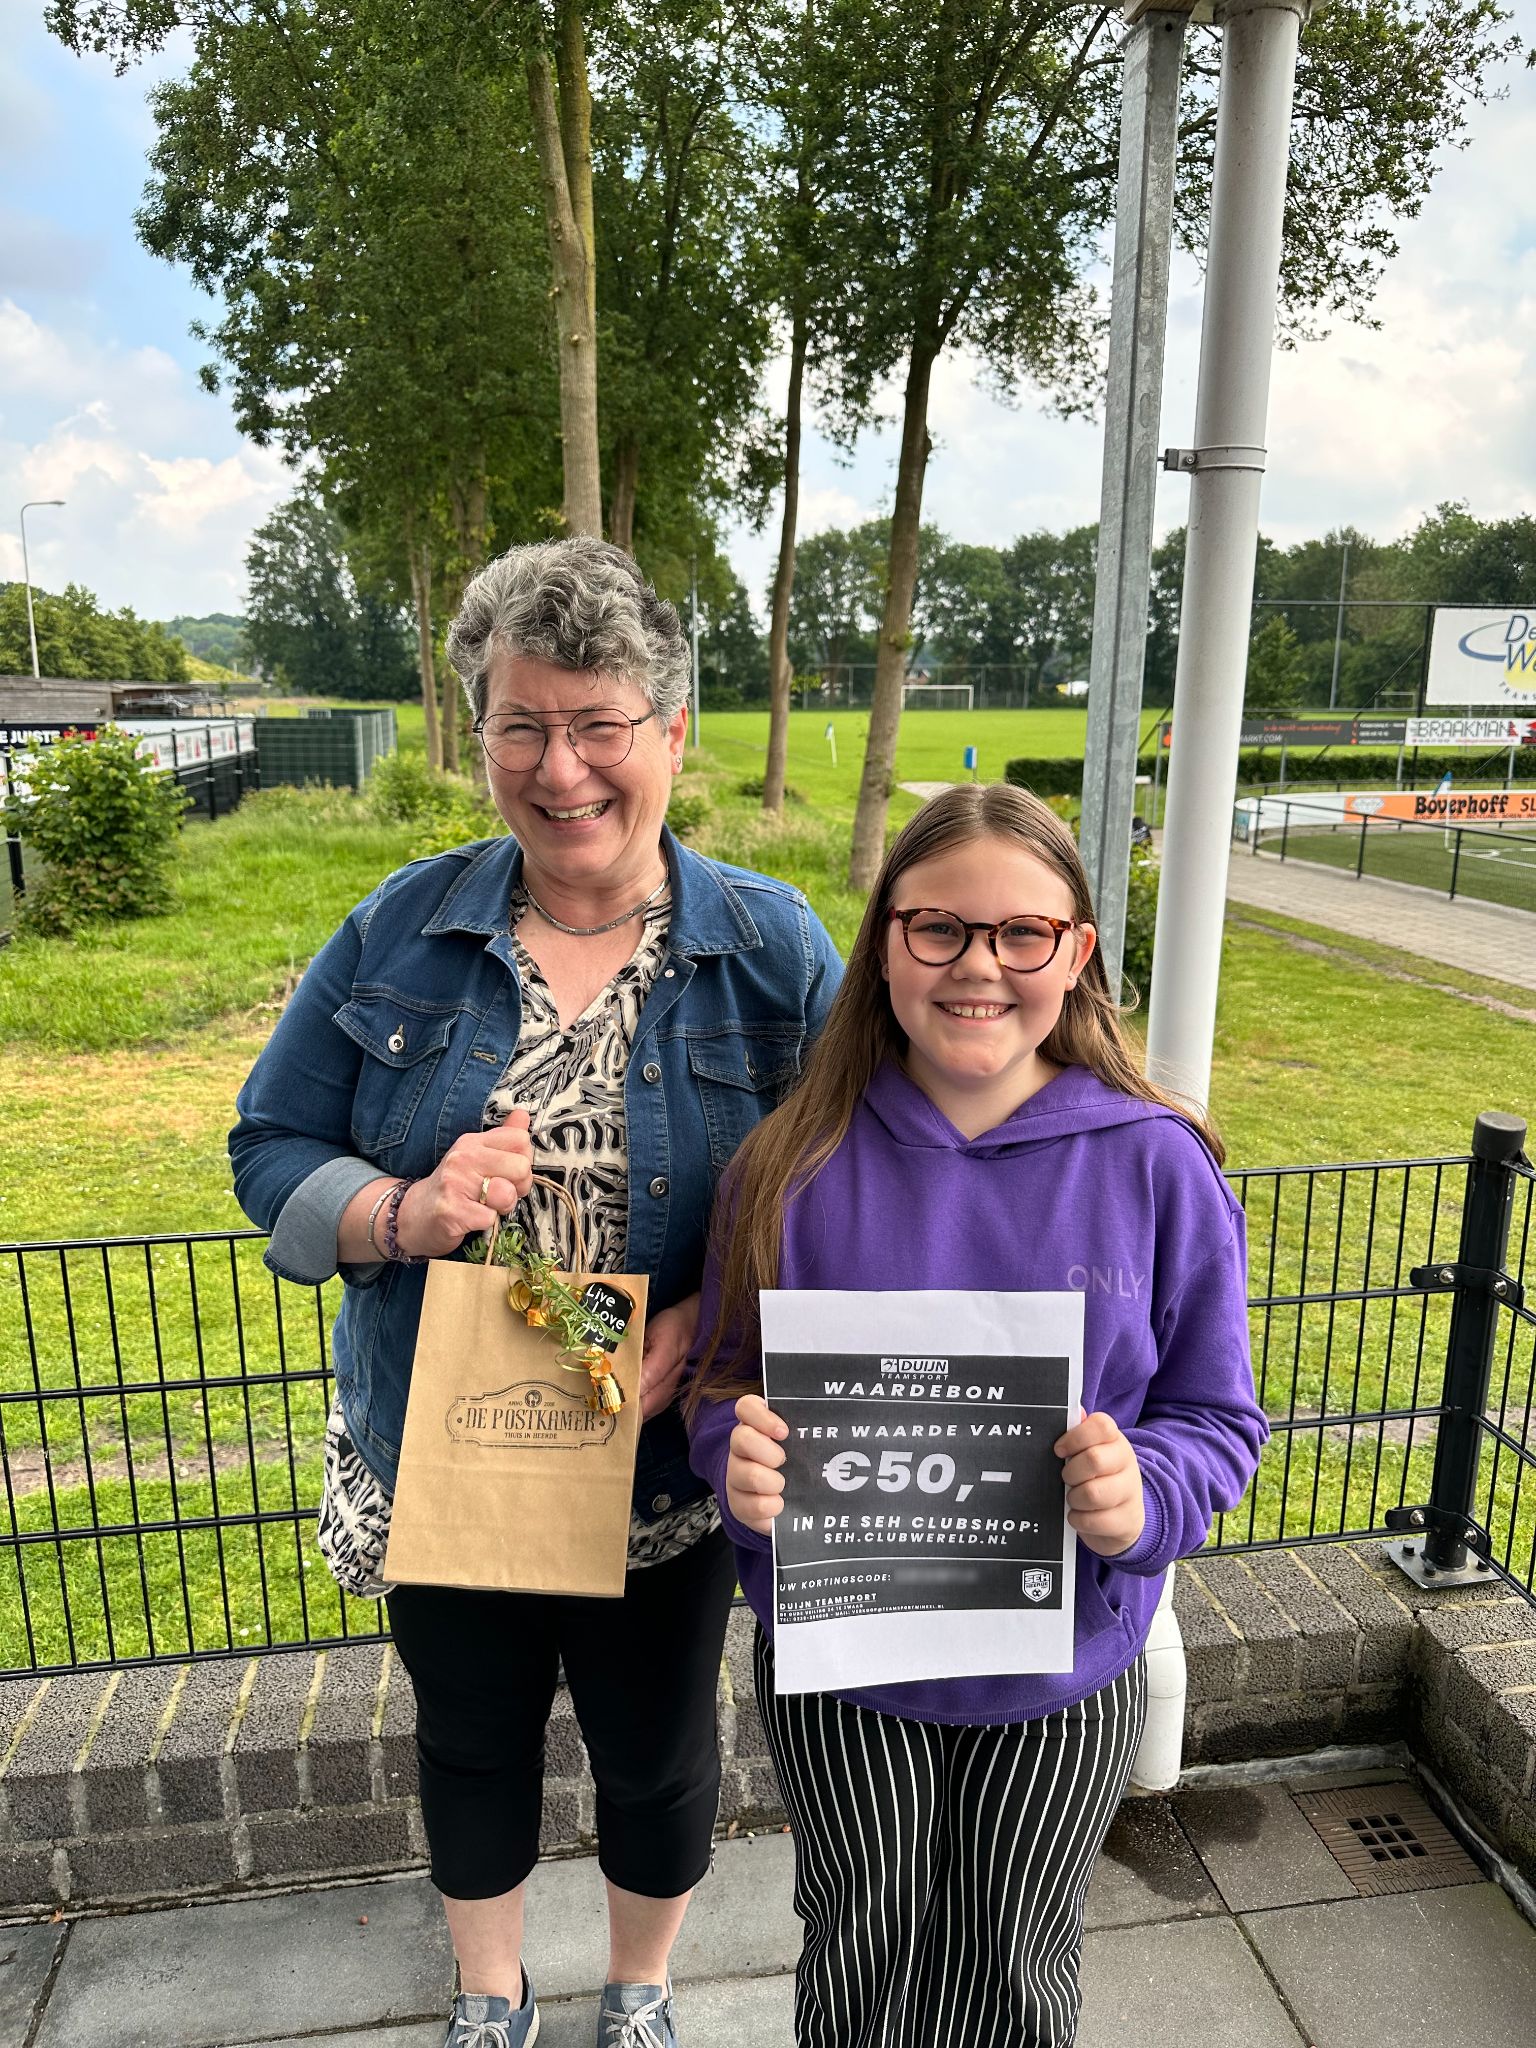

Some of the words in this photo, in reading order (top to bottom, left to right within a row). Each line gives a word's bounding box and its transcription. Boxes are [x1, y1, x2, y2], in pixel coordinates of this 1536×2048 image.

[1417, 720, 1511, 738] BRAAKMAN
[1415, 795, 1509, 815] Boverhoff
[1067, 1264, 1146, 1300] ONLY
[586, 1283, 616, 1307] Live
[591, 1301, 626, 1330] Love
[901, 1360, 947, 1373] DUIJN
[880, 1373, 949, 1381] TEAMSPORT
[824, 1381, 1005, 1400] WAARDEBON
[465, 1407, 488, 1429] DE
[492, 1408, 597, 1432] POSTKAMER
[797, 1426, 839, 1439] TER
[851, 1424, 958, 1438] WAARDE
[970, 1424, 1033, 1437] VAN:
[821, 1450, 1013, 1502] €50,-
[793, 1515, 815, 1532] IN
[824, 1515, 850, 1529] DE
[861, 1515, 902, 1529] SEH
[911, 1515, 1040, 1533] CLUBSHOP:
[824, 1532, 1008, 1546] SEH.CLUBWERELD.NL
[779, 1582, 797, 1592] UW
[801, 1573, 891, 1590] KORTINGSCODE:
[1025, 1574, 1049, 1582] SEH
[779, 1600, 812, 1611] DUIJN
[815, 1593, 877, 1607] TEAMSPORT
